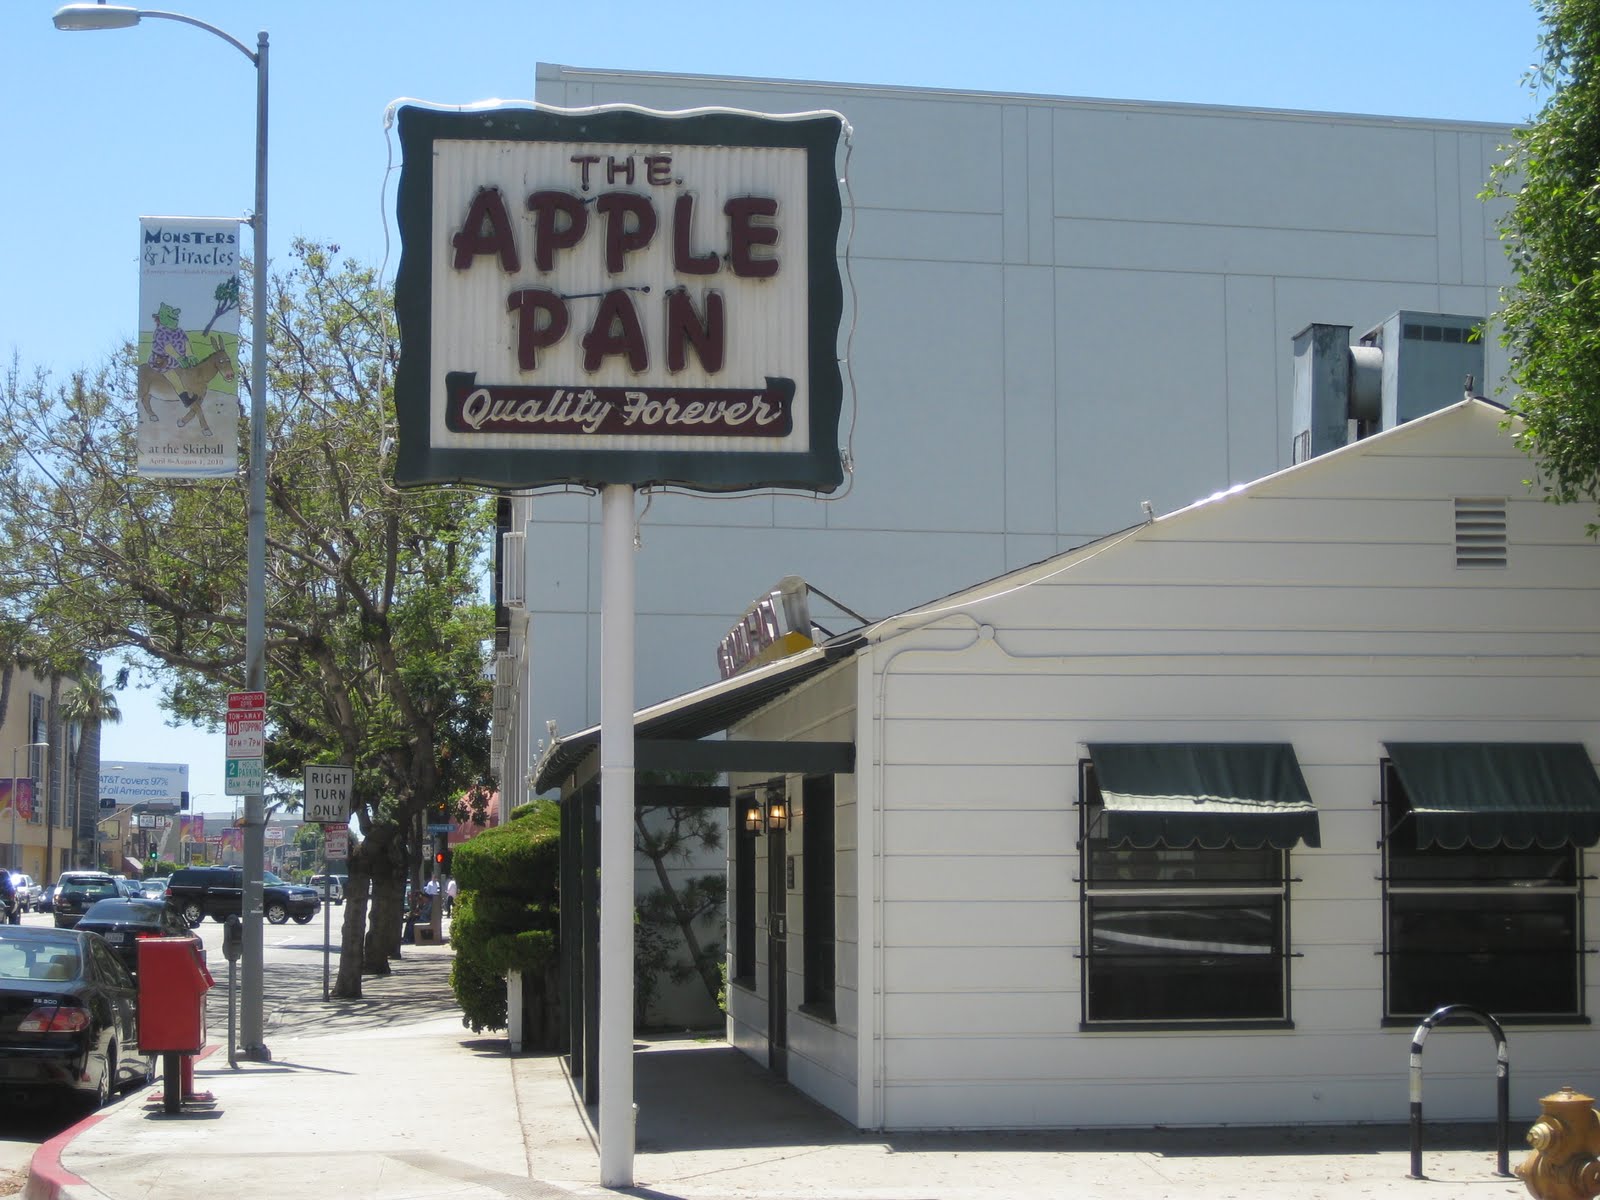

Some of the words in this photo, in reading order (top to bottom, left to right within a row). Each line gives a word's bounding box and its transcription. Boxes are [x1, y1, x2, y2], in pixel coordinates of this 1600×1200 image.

[570, 155, 673, 185] THE
[451, 186, 781, 278] APPLE
[160, 245, 234, 266] Miracles
[506, 287, 725, 374] PAN
[461, 388, 611, 432] Quality
[622, 391, 782, 425] Forever
[148, 445, 159, 454] at
[162, 443, 179, 454] the
[182, 443, 224, 455] Skirball
[228, 712, 262, 720] TOW-AWAY
[228, 721, 238, 735] NO
[240, 721, 262, 732] STOPPING
[229, 762, 235, 776] 2
[239, 768, 261, 777] PARKING
[99, 775, 120, 784] AT&T
[121, 777, 150, 785] covers
[150, 777, 168, 786] 97%
[312, 772, 347, 785] RIGHT
[99, 785, 107, 794] of
[107, 786, 119, 794] all
[314, 788, 346, 800] TURN
[313, 804, 344, 816] ONLY
